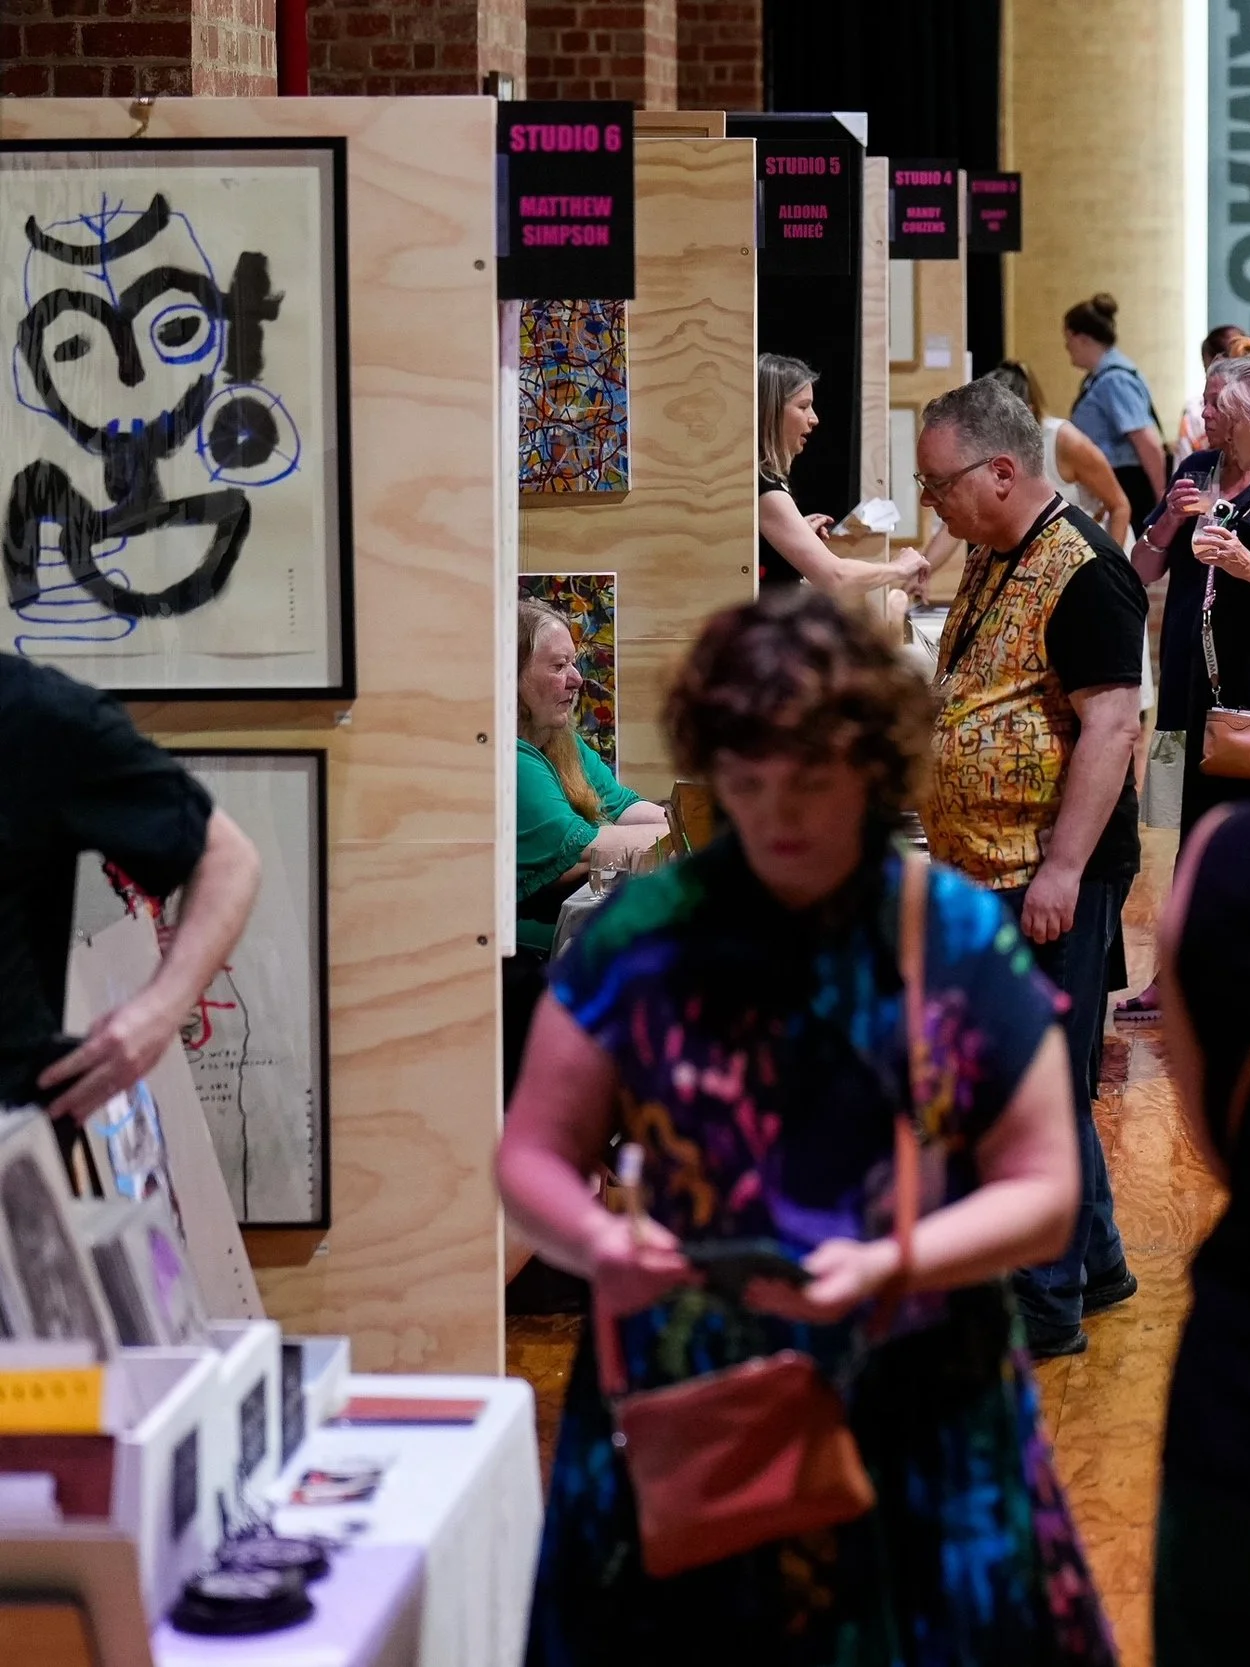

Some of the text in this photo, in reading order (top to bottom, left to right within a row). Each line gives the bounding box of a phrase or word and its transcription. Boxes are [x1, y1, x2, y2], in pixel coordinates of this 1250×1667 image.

[510, 124, 622, 152] STUDIO 6
[765, 156, 841, 175] STUDIO 5
[894, 170, 954, 187] STUDIO 4
[519, 195, 614, 218] MATTHEW
[778, 204, 829, 219] ALDONA
[522, 224, 611, 247] SIMPSON
